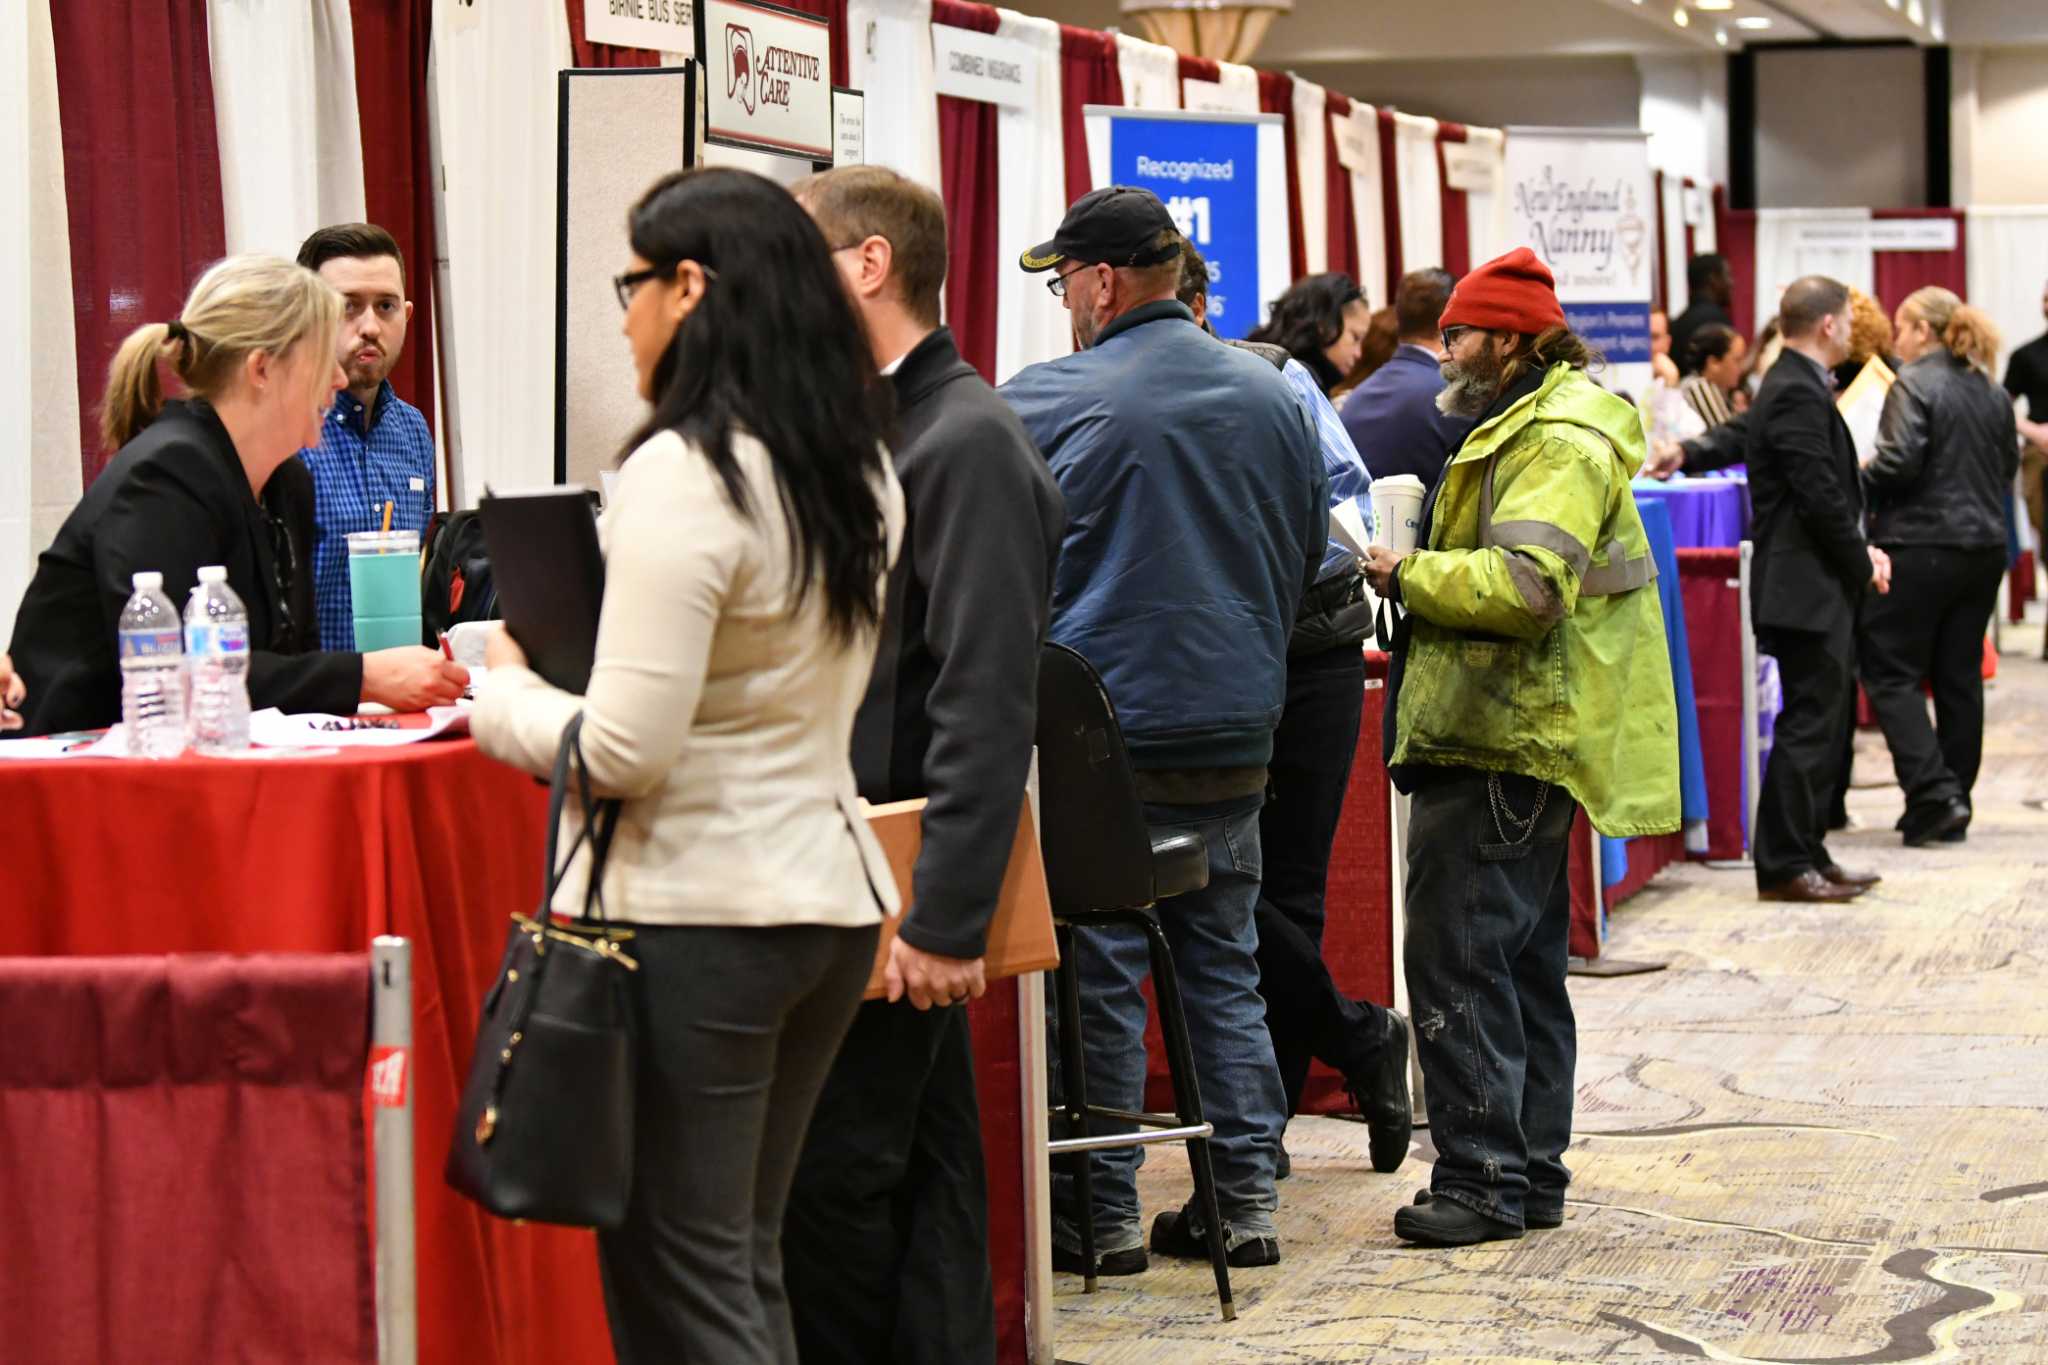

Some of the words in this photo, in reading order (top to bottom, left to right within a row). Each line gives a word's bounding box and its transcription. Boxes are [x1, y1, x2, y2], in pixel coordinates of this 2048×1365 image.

[609, 0, 644, 19] BIRNIE
[648, 0, 669, 23] BUS
[756, 46, 820, 82] ATTENTIVE
[760, 71, 790, 106] CARE
[1136, 155, 1235, 182] Recognized
[1529, 220, 1615, 272] Nanny
